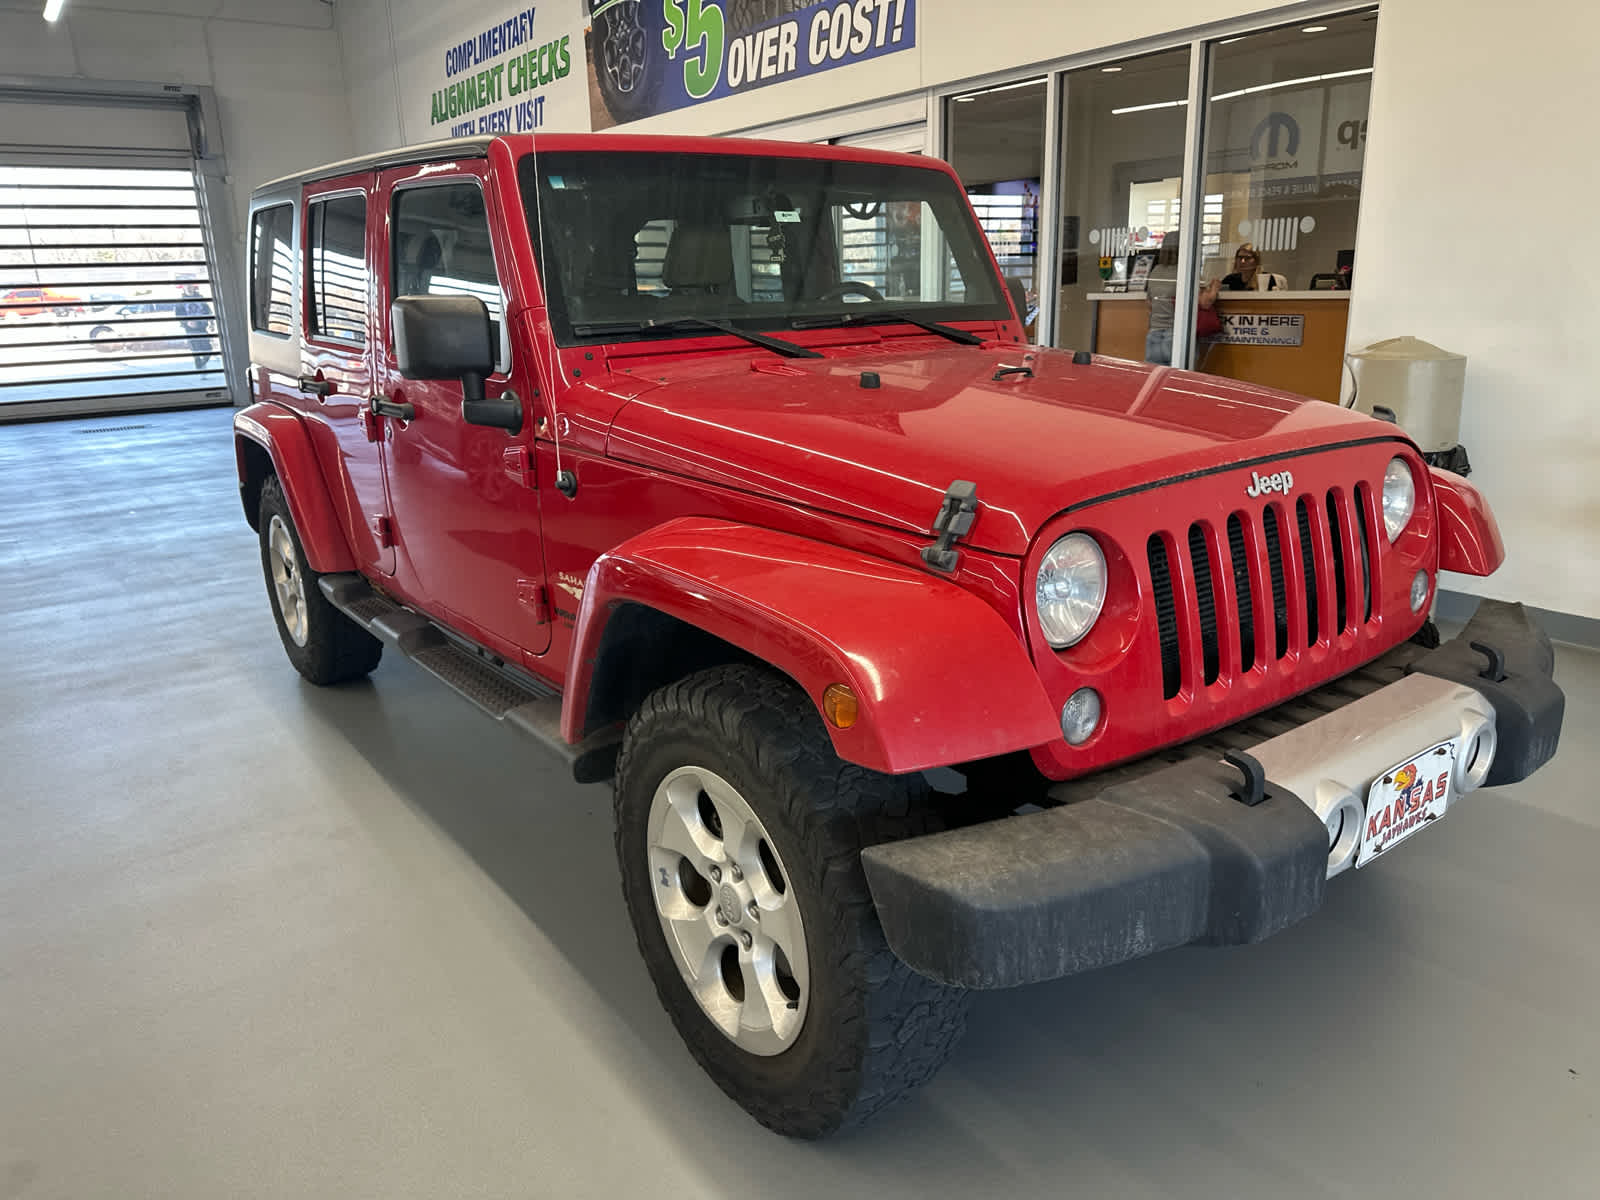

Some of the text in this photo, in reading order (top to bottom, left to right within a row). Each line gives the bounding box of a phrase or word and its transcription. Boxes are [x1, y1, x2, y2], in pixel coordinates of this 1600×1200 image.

[446, 7, 535, 77] COMPLIMENTARY
[727, 0, 906, 88] OVER COST!
[431, 35, 570, 126] ALIGNMENT CHECKS
[515, 96, 545, 132] VISIT
[1233, 327, 1269, 336] TIRE &
[1239, 316, 1254, 326] IN
[1258, 316, 1300, 326] HERE
[1247, 471, 1293, 497] Jeep
[1366, 771, 1449, 842] KANSAS
[1381, 808, 1428, 846] JAYHAWKS
